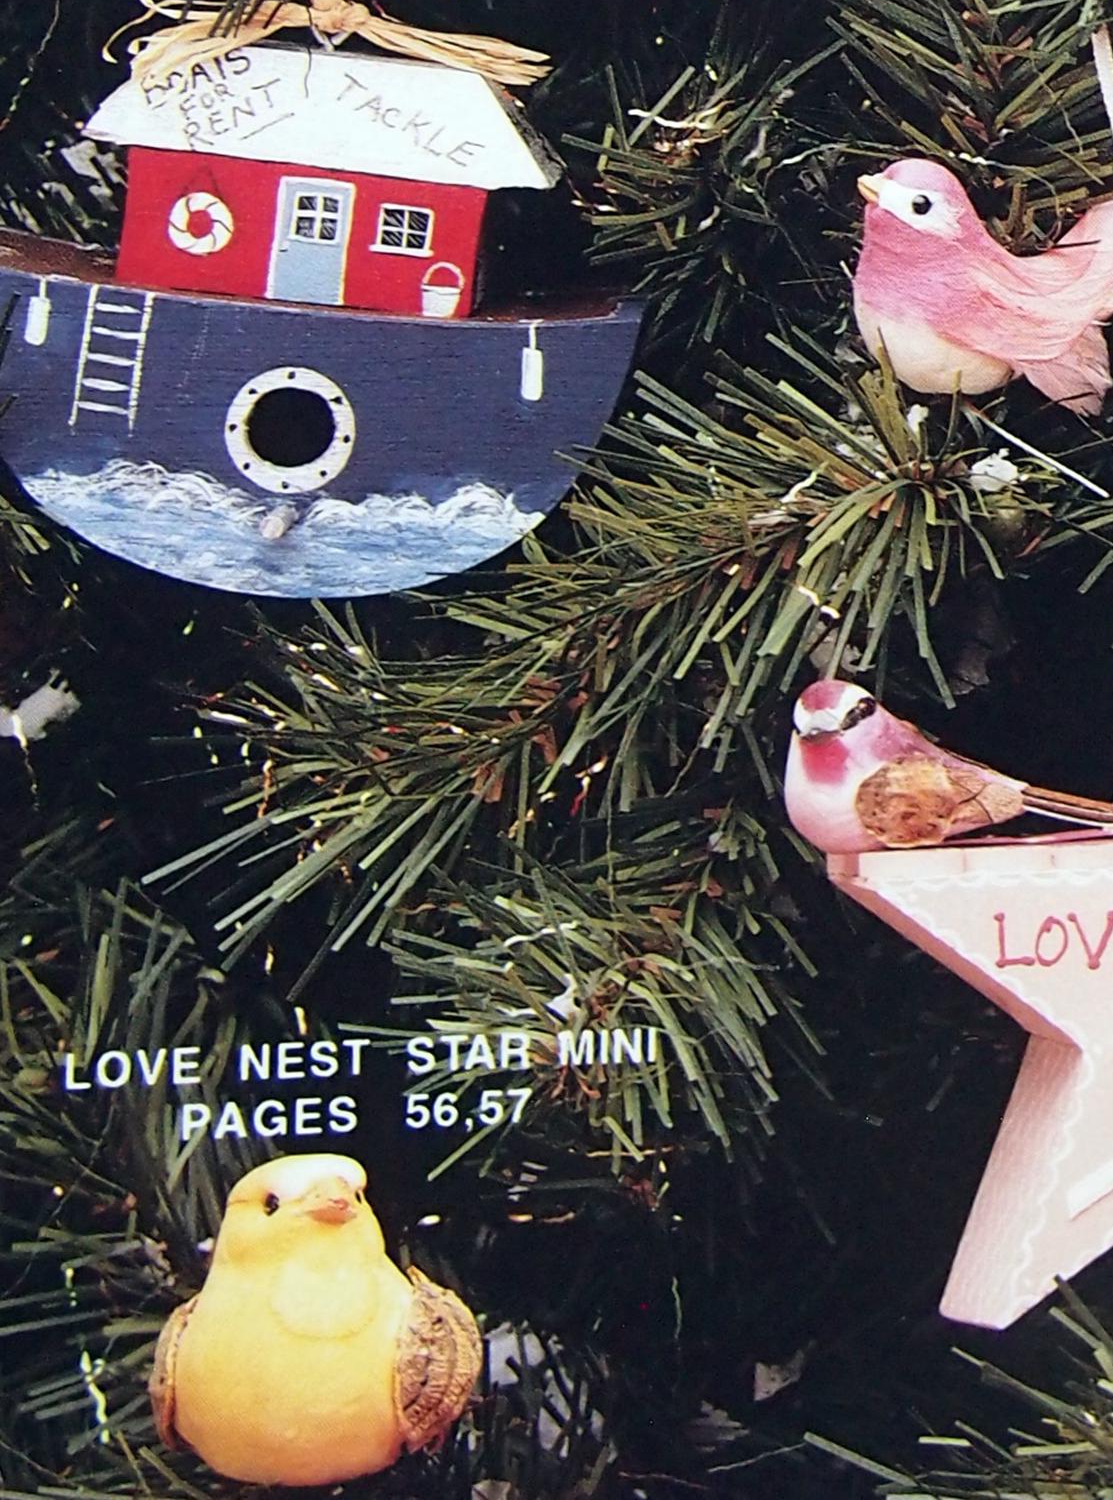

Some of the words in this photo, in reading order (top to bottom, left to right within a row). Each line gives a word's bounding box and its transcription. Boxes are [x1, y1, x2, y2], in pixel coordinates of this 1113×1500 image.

[179, 83, 235, 121] FOR
[183, 77, 282, 151] RENT
[333, 73, 485, 167] TACKLE
